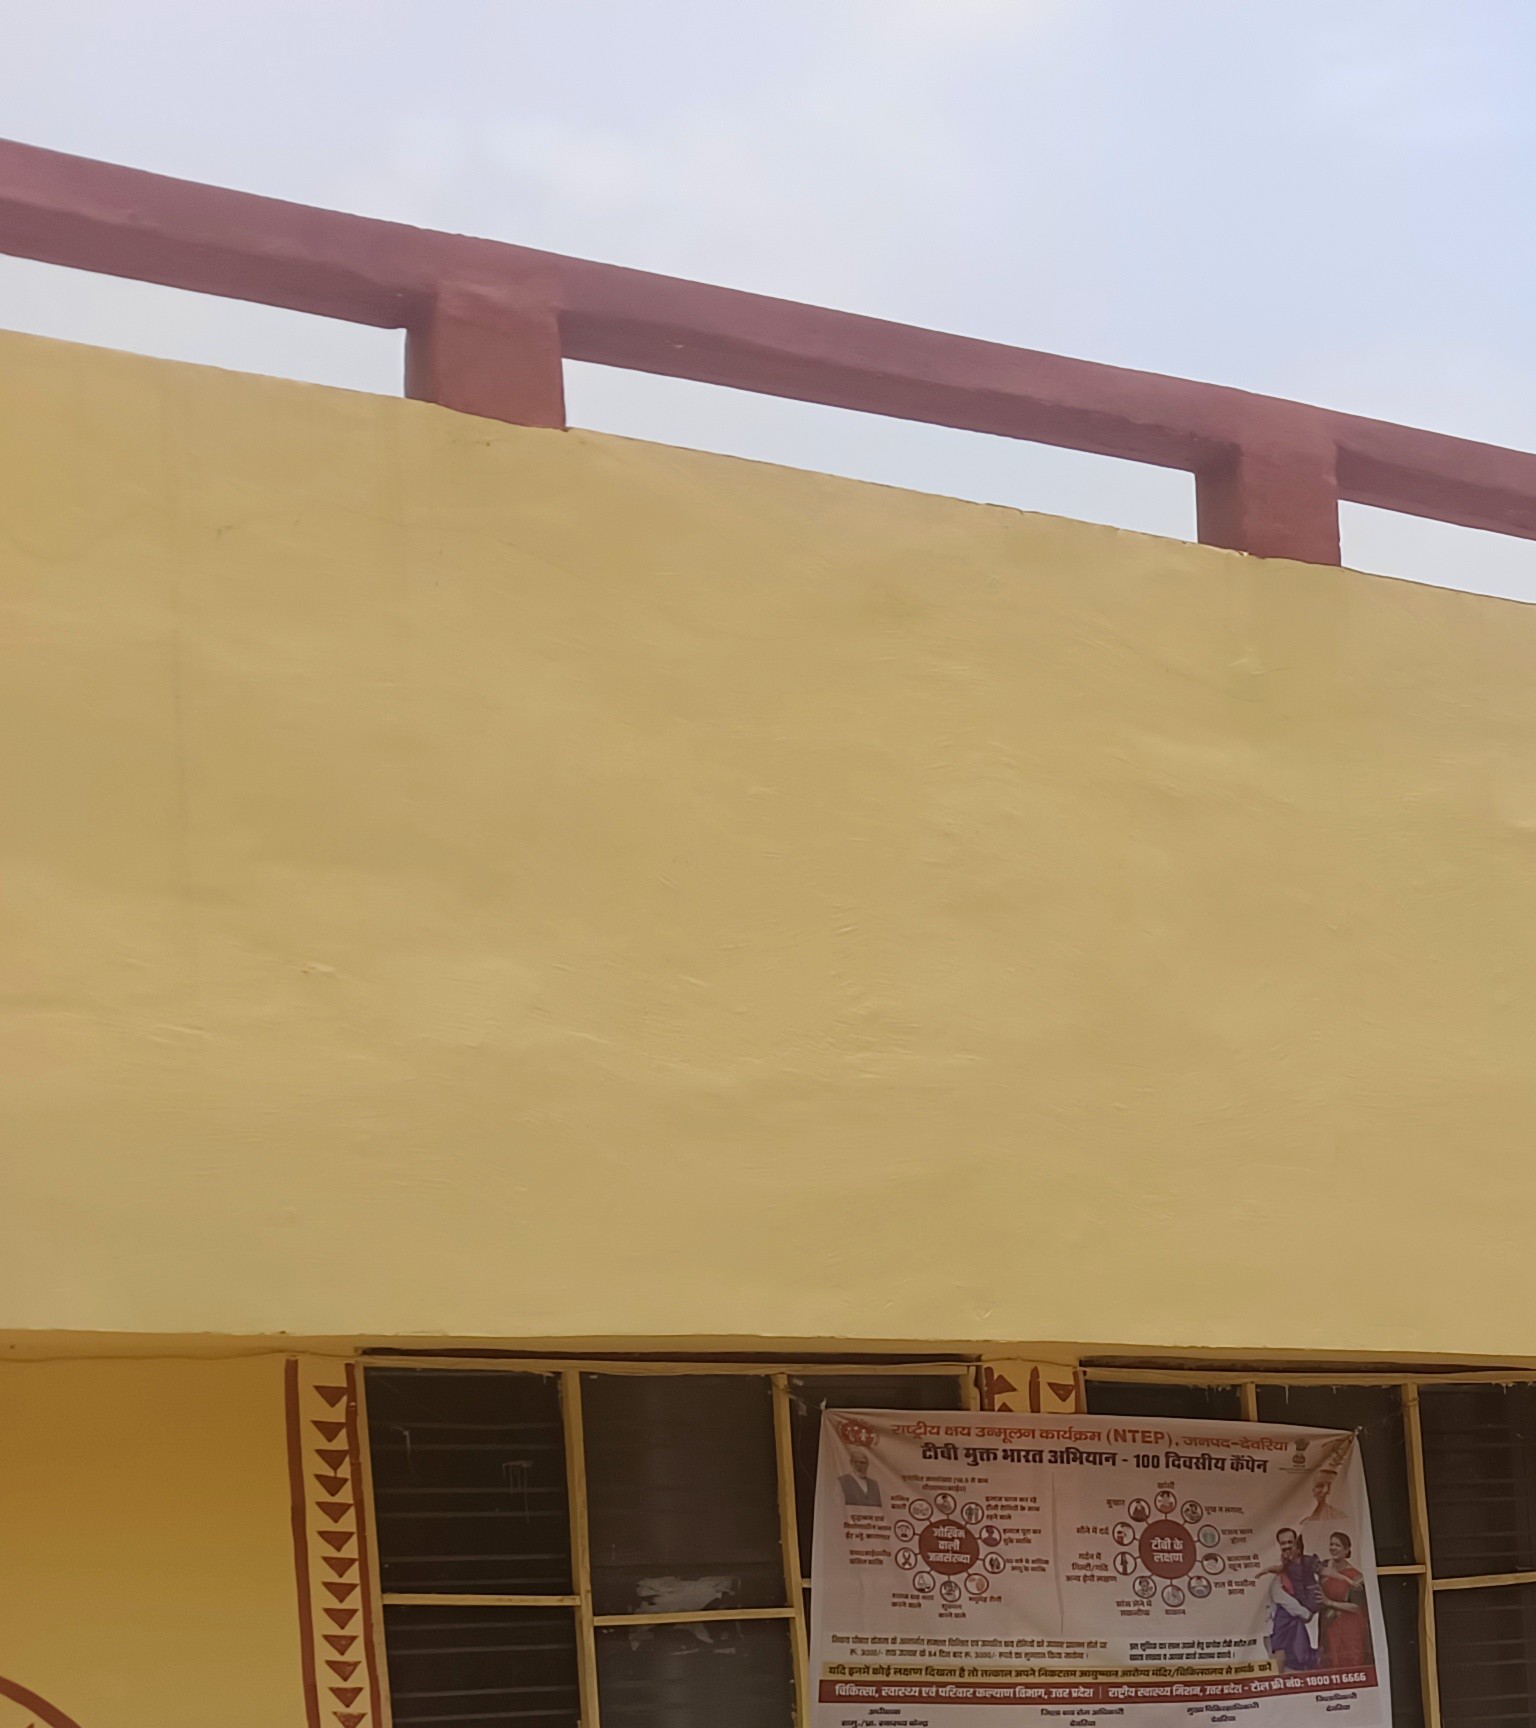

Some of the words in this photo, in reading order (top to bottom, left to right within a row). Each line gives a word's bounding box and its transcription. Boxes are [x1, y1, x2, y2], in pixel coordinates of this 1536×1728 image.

[891, 1421, 941, 1439] राष्ट्रीय
[944, 1426, 971, 1437] क्षय
[976, 1426, 1036, 1444] उन्मूलन
[1039, 1425, 1101, 1442] कार्यक्रम
[964, 1447, 999, 1467] मुक्त
[1002, 1448, 1044, 1464] भारत
[1048, 1447, 1118, 1466] अभियान
[1133, 1453, 1160, 1468] 100
[1165, 1451, 1226, 1471] दिवसीय
[1153, 1552, 1184, 1563] लक्षण
[1306, 1675, 1330, 1686] 1800
[1332, 1675, 1341, 1684] 11
[939, 1685, 973, 1698] परिवार
